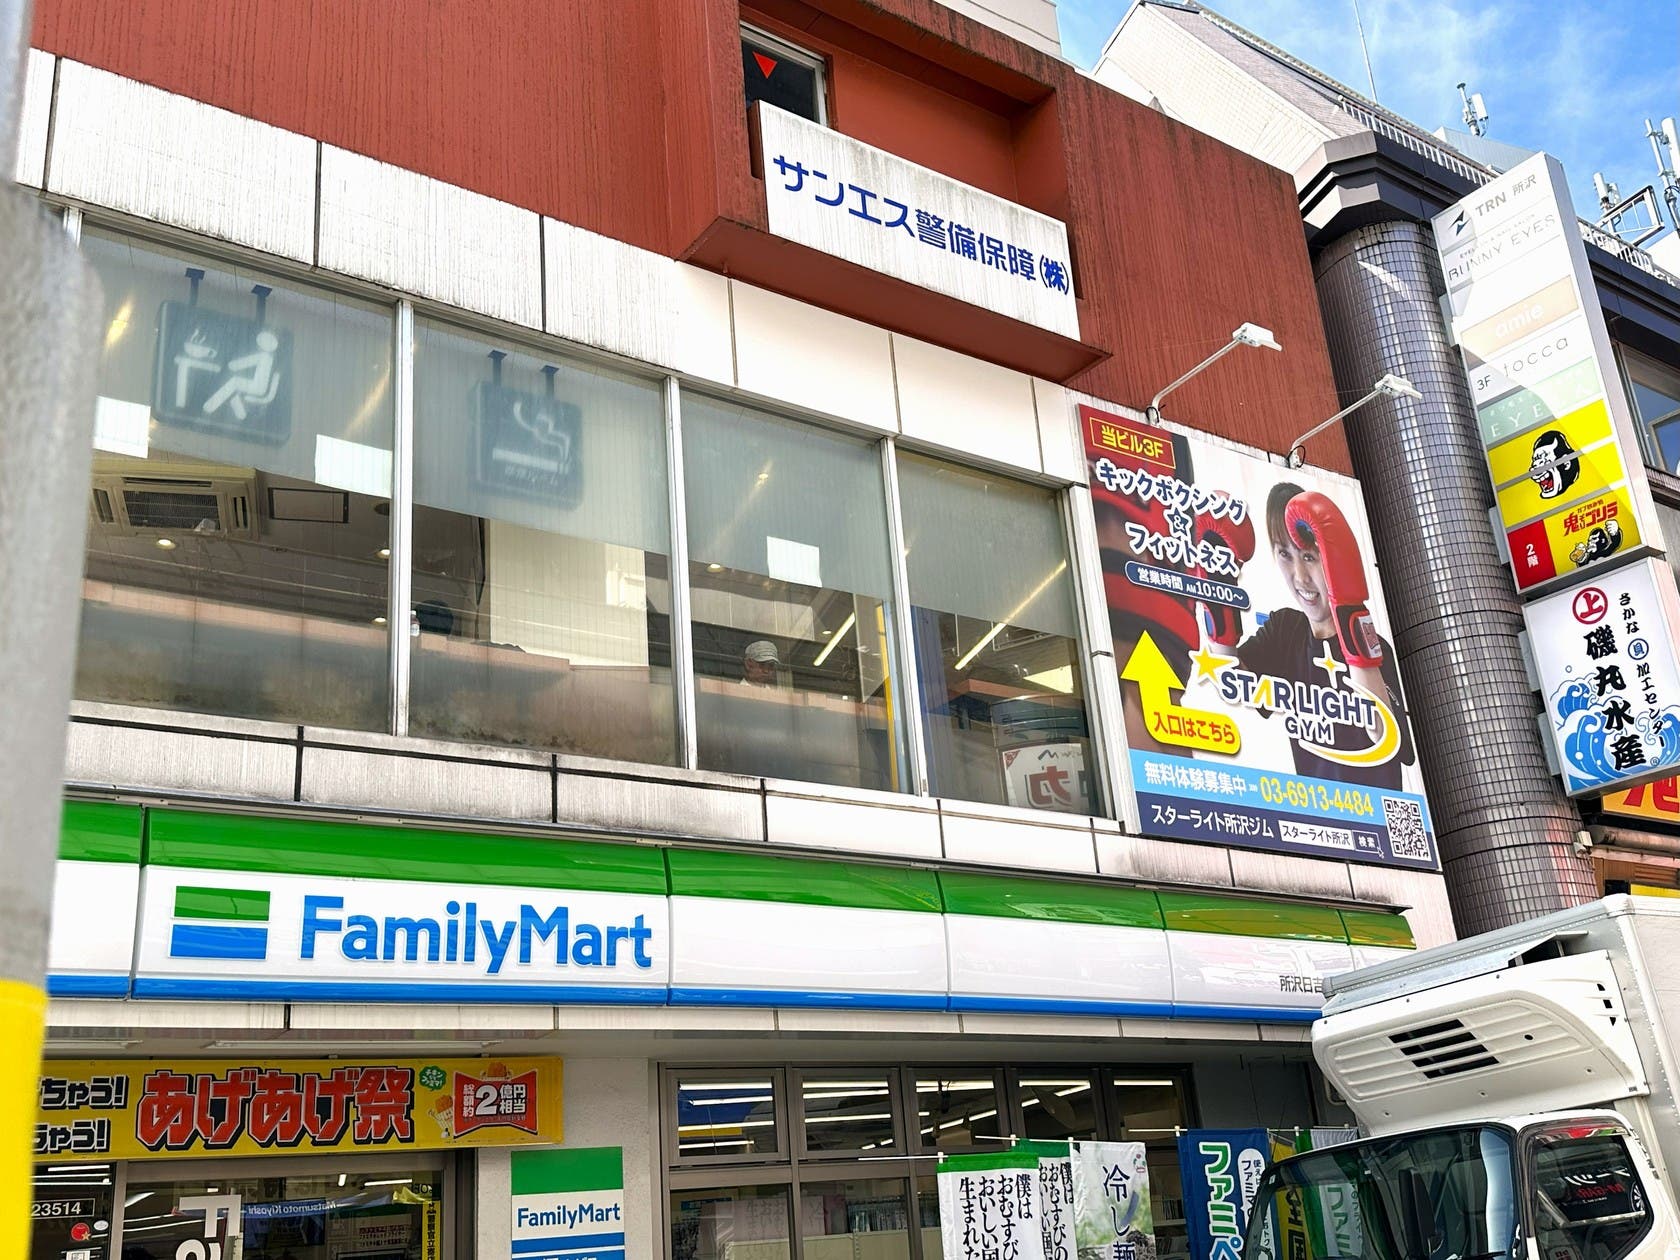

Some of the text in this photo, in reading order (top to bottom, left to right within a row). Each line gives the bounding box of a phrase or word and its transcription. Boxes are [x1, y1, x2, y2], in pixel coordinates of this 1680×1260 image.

[1475, 174, 1537, 217] TRN 所沢
[1511, 214, 1556, 246] EYES
[1476, 375, 1491, 391] 3F
[1101, 425, 1163, 458] 当ビル3F
[1099, 461, 1245, 522] キックボクシング
[1128, 526, 1238, 573] フィットネス
[1137, 568, 1184, 590] 営業時間
[1295, 685, 1377, 727] LIGHT
[1583, 624, 1647, 771] 磯丸水産
[1153, 711, 1236, 745] 入口はこちら
[1285, 717, 1335, 745] GYM
[1144, 761, 1375, 817] 無料体験募集中 03-6913-4484
[1151, 805, 1274, 839] スターライト所沢ジム
[1283, 825, 1351, 846] スターライト所沢
[303, 894, 652, 974] FamilyMart
[136, 1067, 416, 1152] あげあげ祭
[475, 1085, 498, 1116] 2
[517, 1203, 621, 1229] FamilyMart
[1015, 1174, 1033, 1219] 僕は
